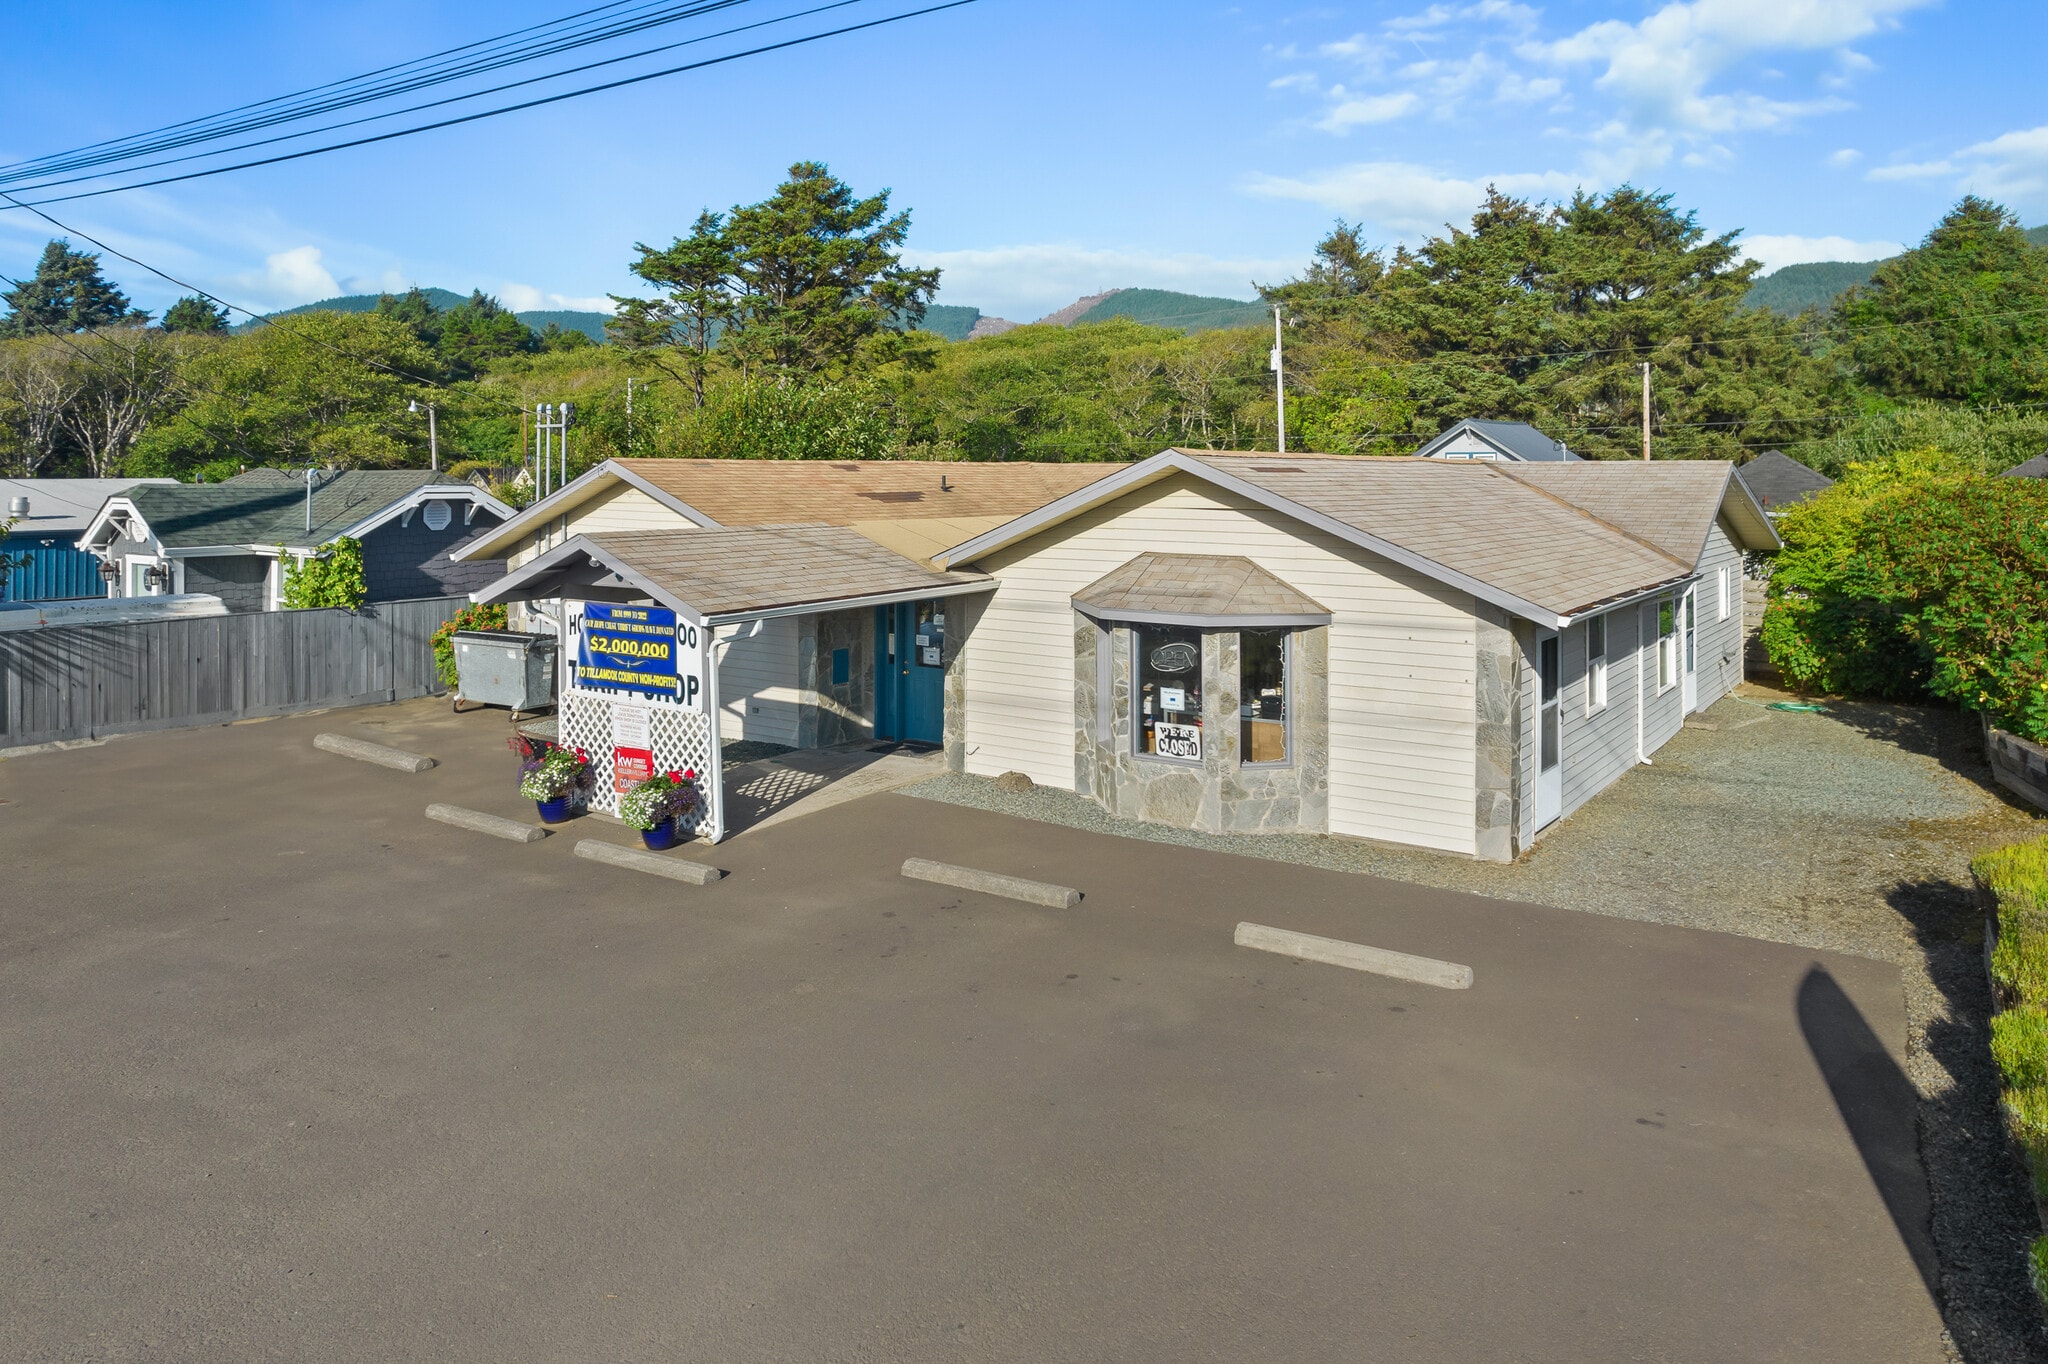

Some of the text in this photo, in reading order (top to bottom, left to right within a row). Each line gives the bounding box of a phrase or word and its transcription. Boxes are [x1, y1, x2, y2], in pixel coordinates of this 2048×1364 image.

[678, 623, 697, 649] OO
[590, 636, 668, 658] $2,000,000
[577, 666, 586, 676] TO
[587, 667, 618, 682] TILLAMOOK
[618, 671, 639, 684] COUNTY
[1160, 727, 1194, 738] WE'RE
[1159, 738, 1197, 756] CLOSED
[618, 752, 633, 767] kw
